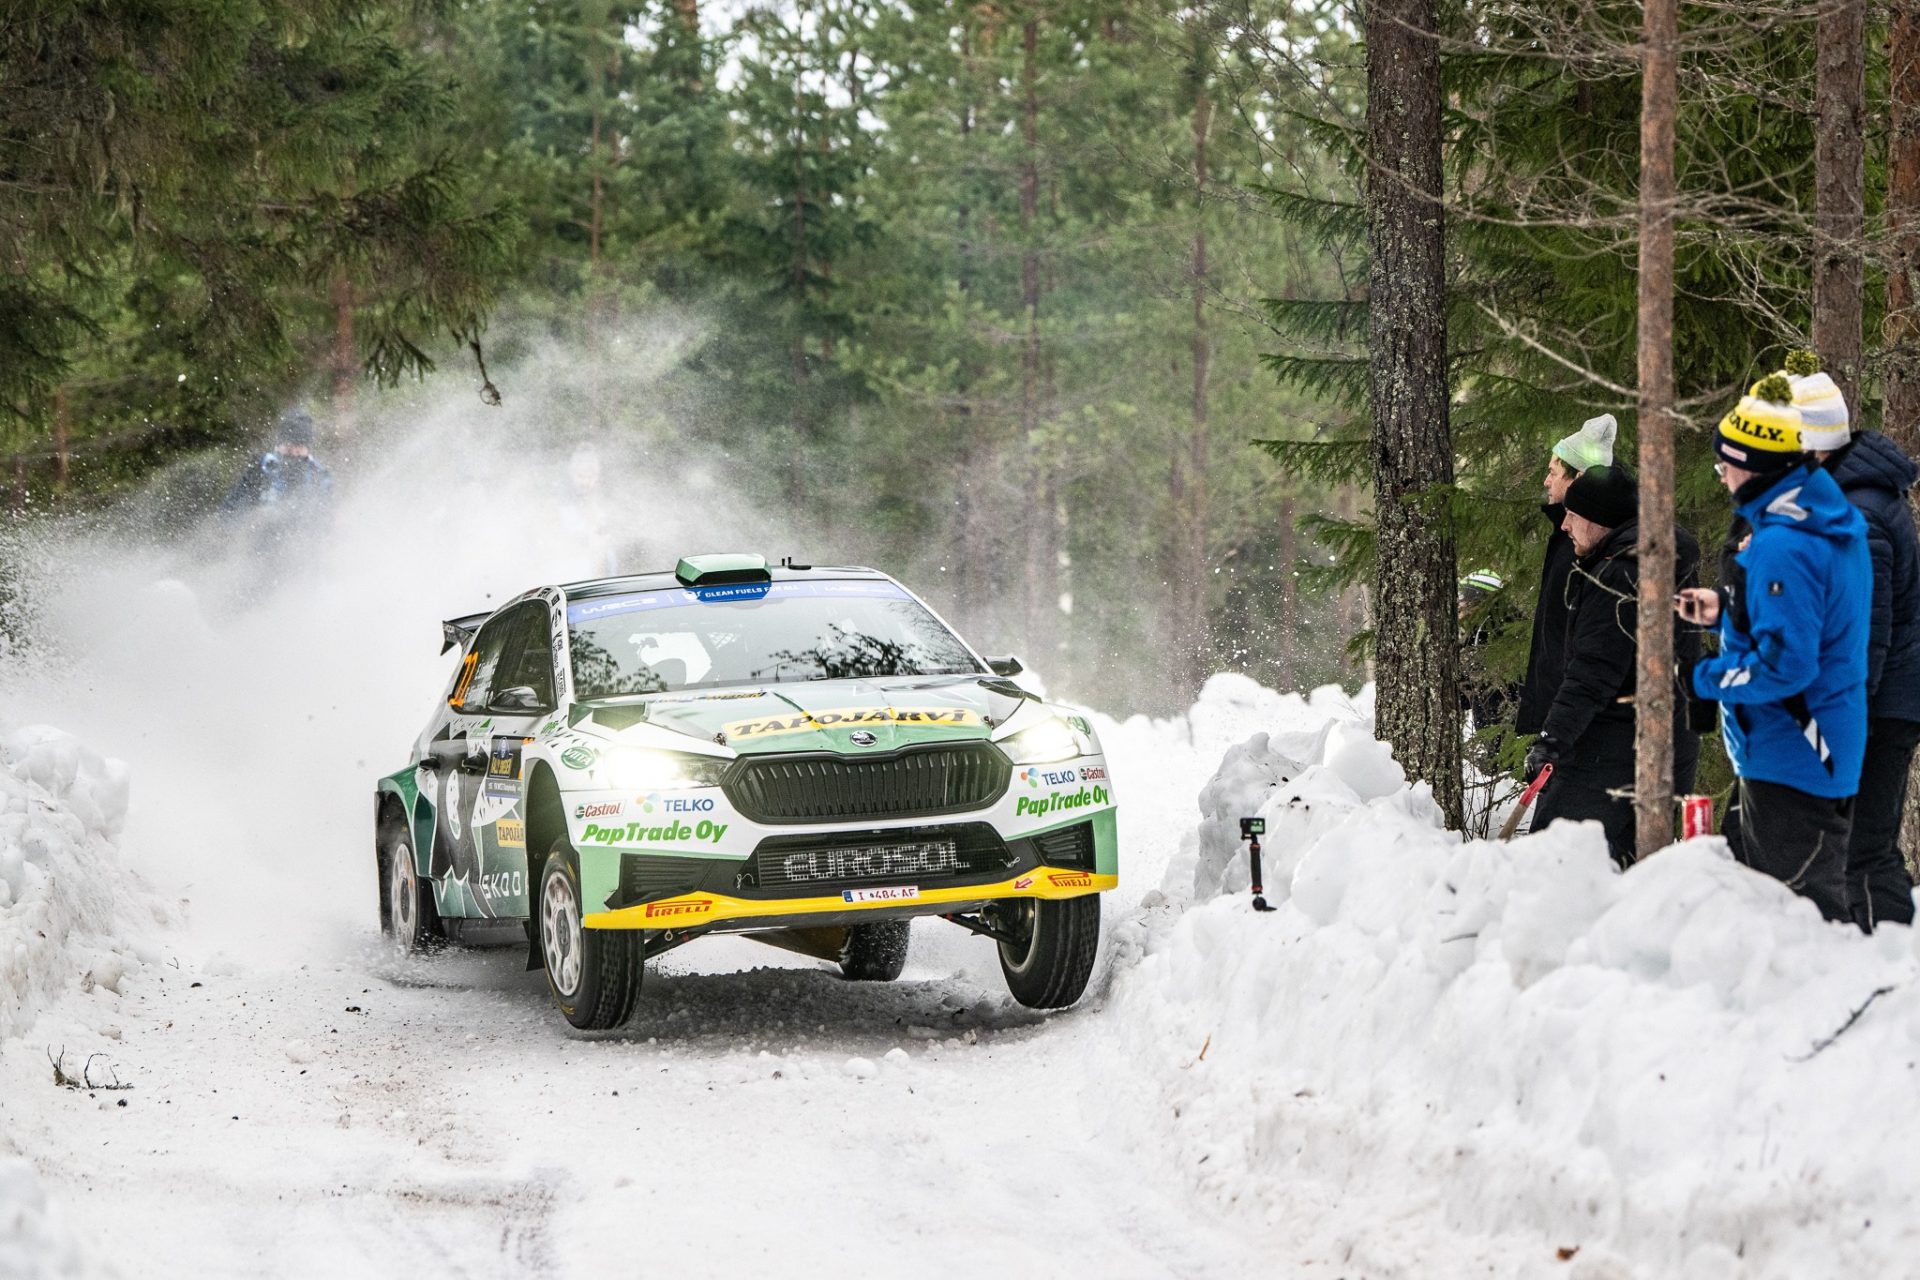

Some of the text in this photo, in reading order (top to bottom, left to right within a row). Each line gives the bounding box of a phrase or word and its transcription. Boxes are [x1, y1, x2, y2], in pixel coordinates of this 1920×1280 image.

[705, 589, 734, 598] CLEAN
[736, 587, 763, 595] FUELS
[1041, 770, 1076, 786] TELKO
[1086, 767, 1106, 780] Castrol
[663, 798, 714, 812] TELKO
[1016, 785, 1110, 817] PapTrade Oy
[585, 802, 622, 818] Castrol
[580, 819, 728, 845] PapTrade Oy
[784, 842, 970, 881] EUROSOL
[1047, 872, 1092, 887] PIRELLI
[645, 900, 713, 918] PIRELLI
